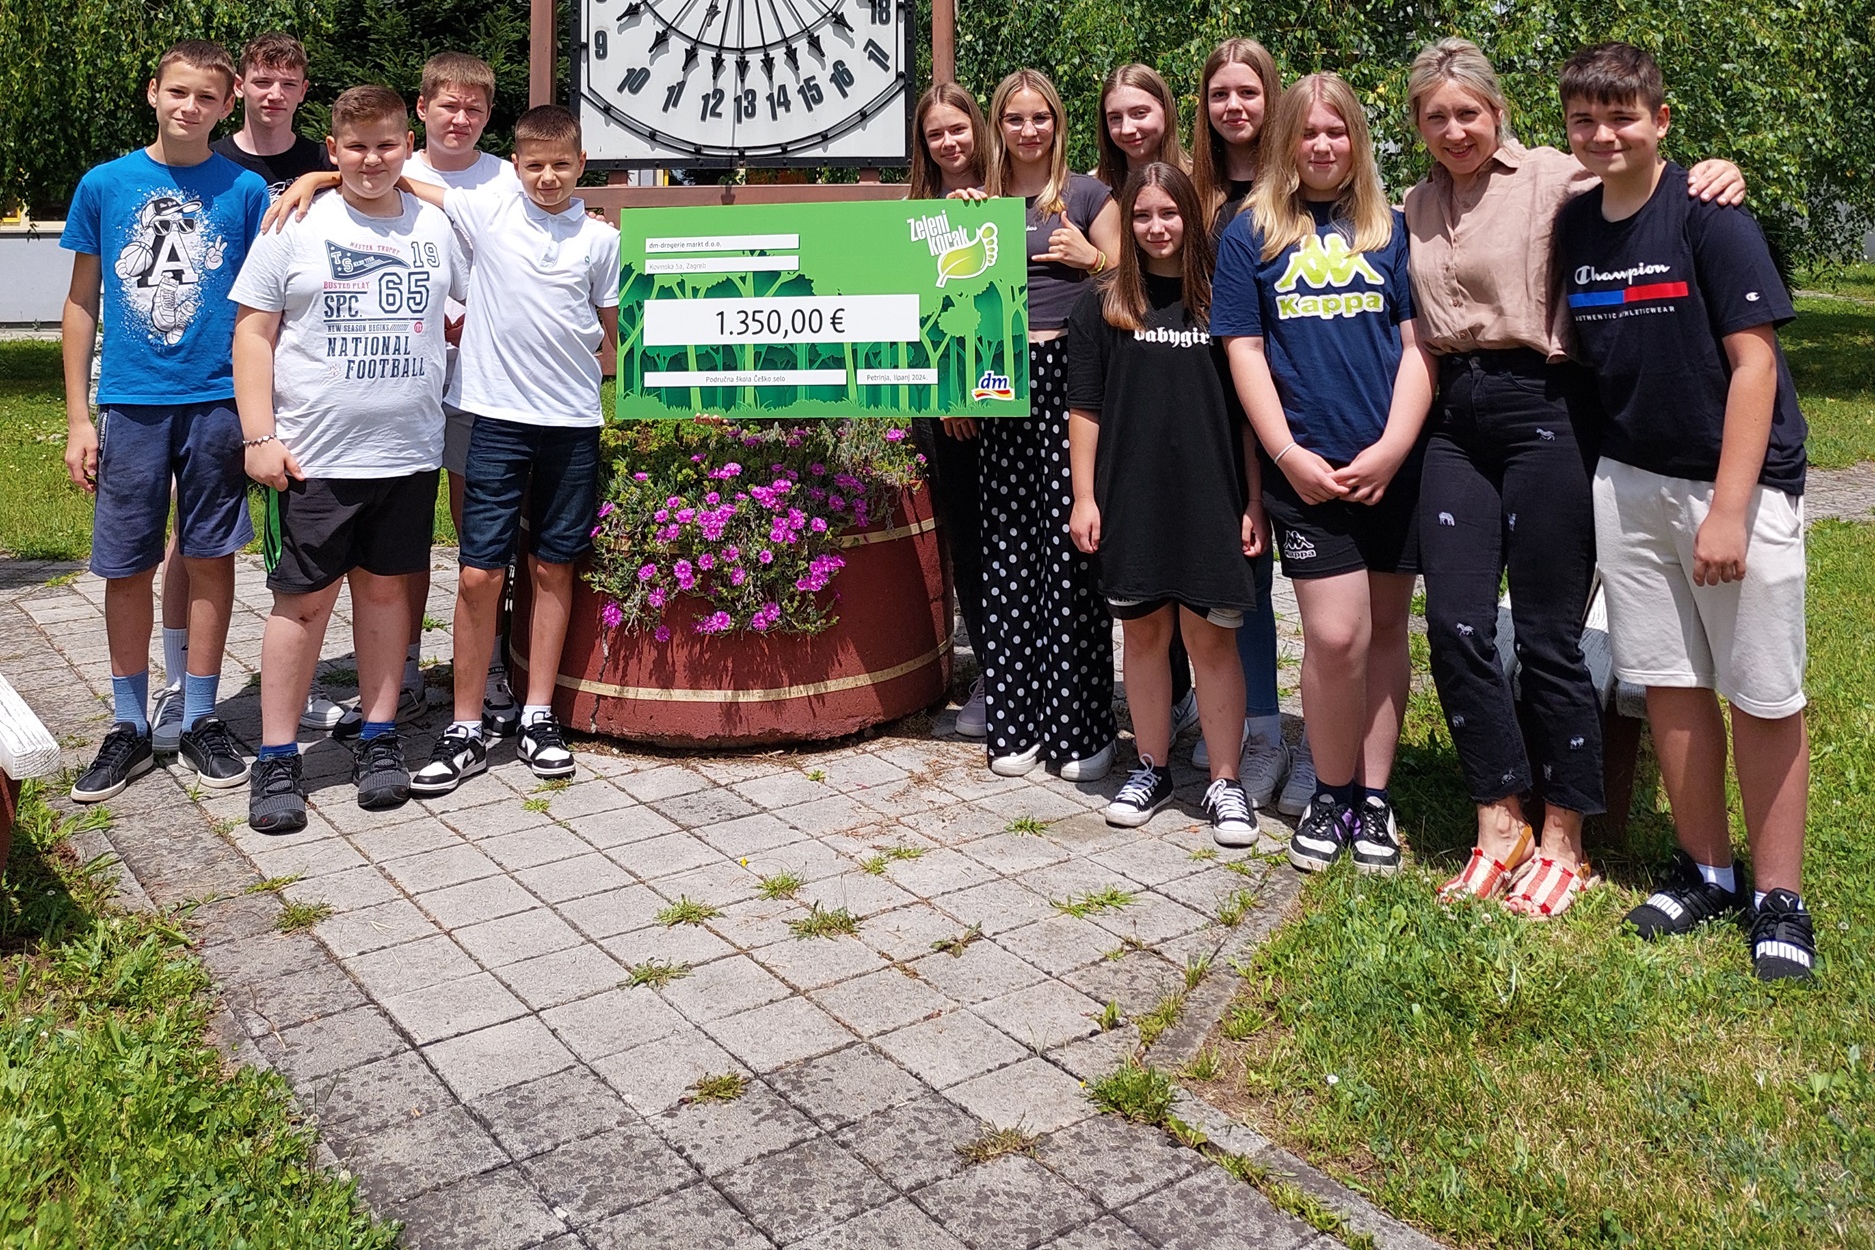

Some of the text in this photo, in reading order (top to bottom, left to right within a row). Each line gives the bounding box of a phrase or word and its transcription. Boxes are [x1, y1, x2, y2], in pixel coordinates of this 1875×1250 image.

[594, 30, 608, 60] 9
[863, 38, 890, 73] 17
[617, 67, 651, 95] 10
[829, 59, 855, 99] 16
[662, 81, 687, 112] 11
[700, 89, 723, 122] 12
[734, 89, 757, 124] 13
[766, 84, 792, 121] 14
[797, 75, 824, 112] 15
[906, 209, 951, 242] Zeleni
[349, 241, 401, 256] MASTER TROPHY
[411, 241, 441, 268] 19
[649, 241, 685, 249] dm-drogerie
[705, 240, 722, 248] d.o.o.
[928, 225, 971, 257] korak
[147, 230, 199, 286] A
[686, 262, 707, 271] Zagreb
[323, 281, 370, 290] BUSTED PLAY
[1574, 262, 1671, 285] Champion
[378, 271, 430, 314] 65
[1276, 291, 1384, 320] Kappa
[327, 324, 342, 333] NEW
[343, 324, 367, 332] SEASON
[716, 307, 846, 339] 1.350,00 €
[326, 335, 411, 358] NATIONAL
[345, 357, 425, 380] FOOTBALL
[705, 375, 735, 384] Područna
[773, 374, 786, 382] selo
[866, 373, 892, 382] Petrinja,
[911, 373, 928, 381] 2024.
[980, 372, 1008, 389] dm
[1647, 893, 1684, 921] UMA
[1755, 940, 1810, 968] PUMA
